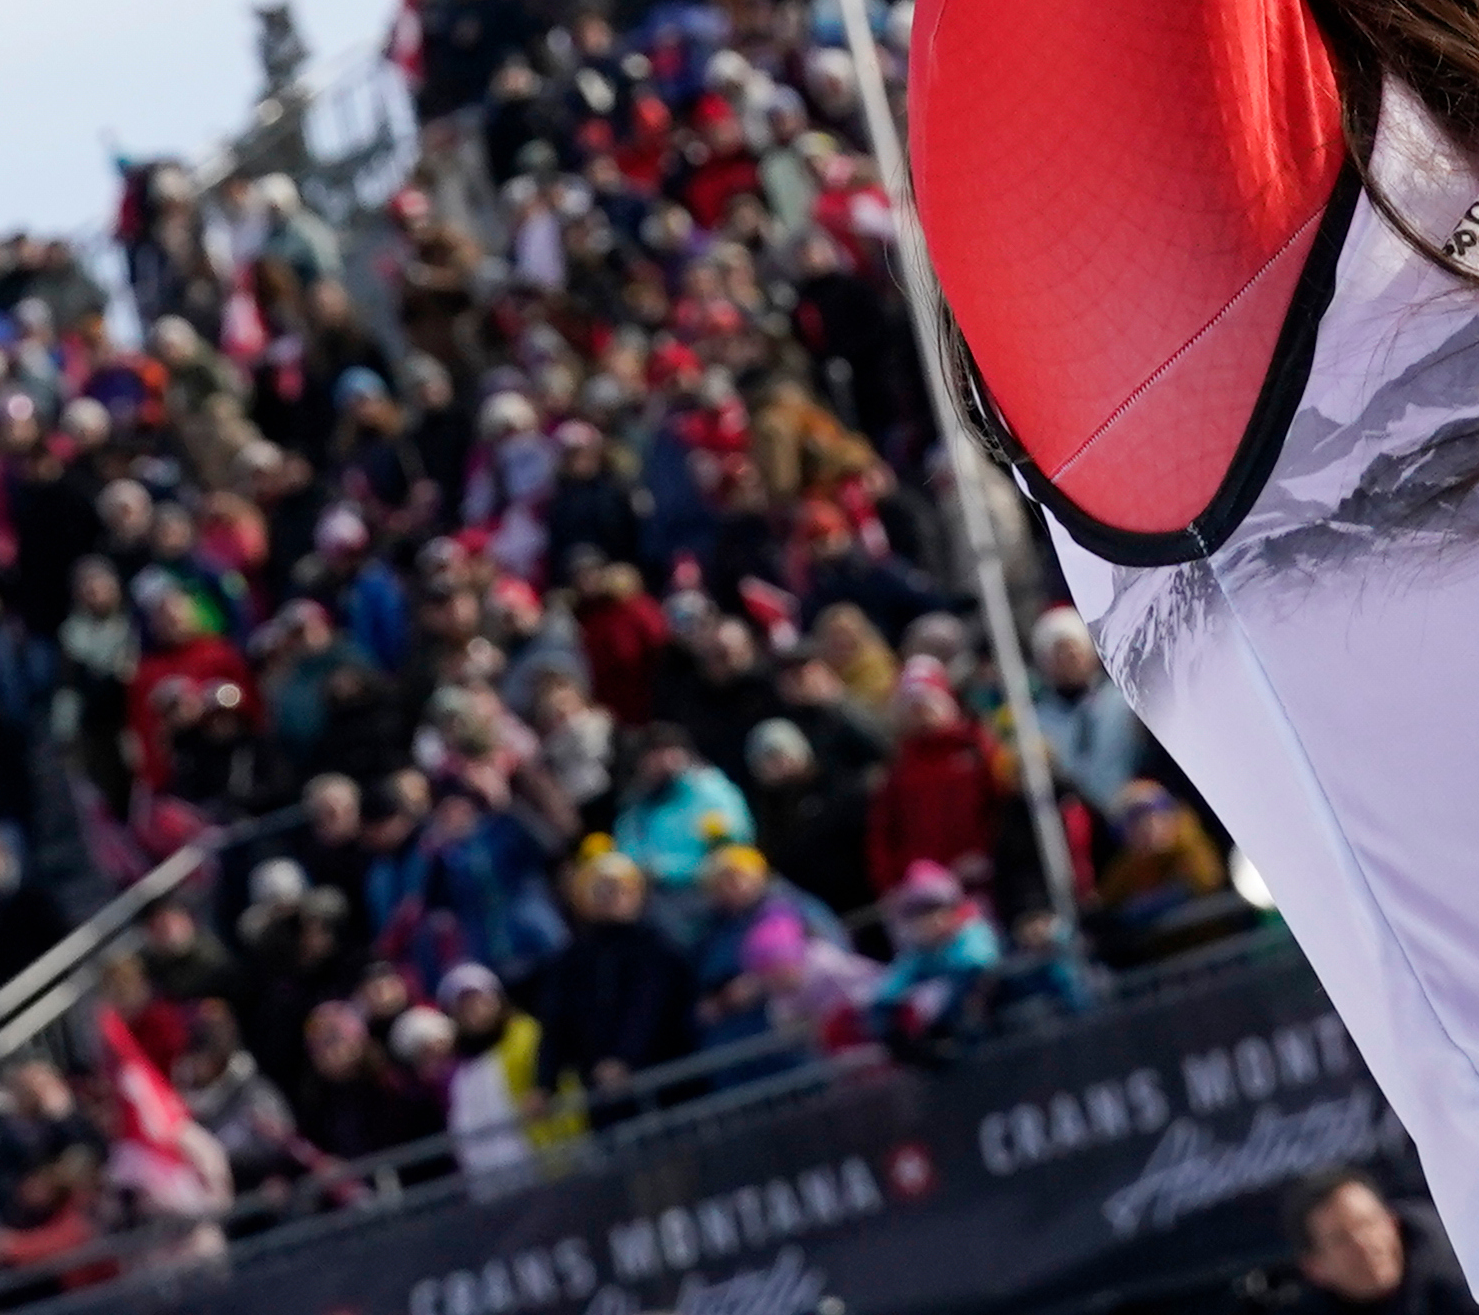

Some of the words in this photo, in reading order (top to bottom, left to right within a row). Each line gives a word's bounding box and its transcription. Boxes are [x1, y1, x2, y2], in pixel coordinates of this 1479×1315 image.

[977, 1067, 1171, 1178] CRANS
[1180, 1009, 1355, 1115] MONT
[607, 1155, 885, 1280] MONTANA
